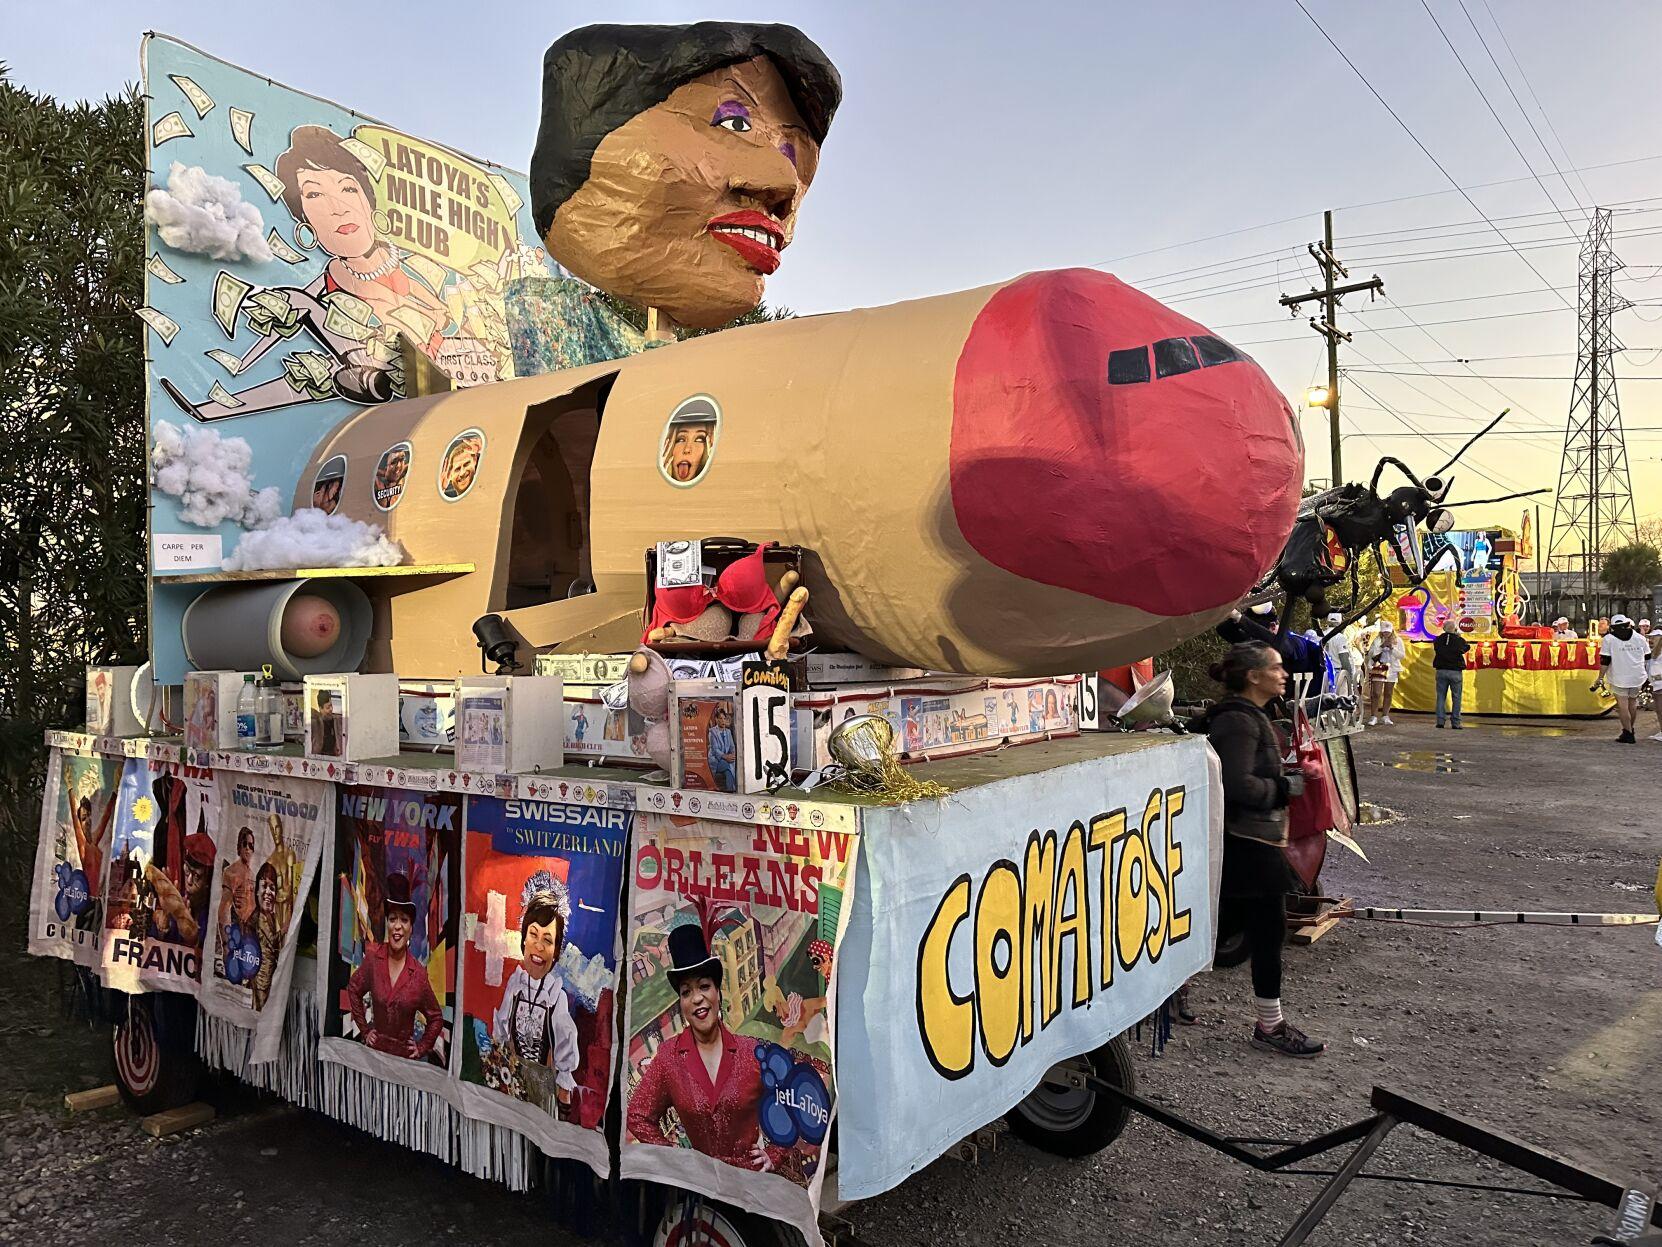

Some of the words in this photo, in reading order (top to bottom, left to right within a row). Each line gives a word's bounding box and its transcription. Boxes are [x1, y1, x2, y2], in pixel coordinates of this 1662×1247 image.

[382, 137, 490, 209] LATOYA'S
[386, 173, 443, 222] MILE
[448, 197, 499, 252] HIGH
[387, 208, 450, 258] CLUB
[440, 354, 462, 366] FIRST
[464, 354, 497, 367] CLASS
[377, 485, 401, 500] SECURITY
[190, 543, 204, 551] PER
[1080, 672, 1096, 722] 15
[752, 695, 789, 783] 15
[232, 789, 318, 821] HOLLYWOOD
[341, 793, 389, 822] NEW
[392, 800, 458, 831] YORK
[505, 800, 625, 830] SWISSAIR
[368, 834, 381, 843] FLY
[384, 830, 420, 848] TWA
[515, 828, 622, 857] SWITZERLAND
[753, 824, 850, 863] NEW
[635, 844, 823, 915] ORLEANS
[916, 785, 1191, 1081] COMATOSE
[232, 946, 260, 967] jetLaToya
[774, 1083, 829, 1125] jetLaToya
